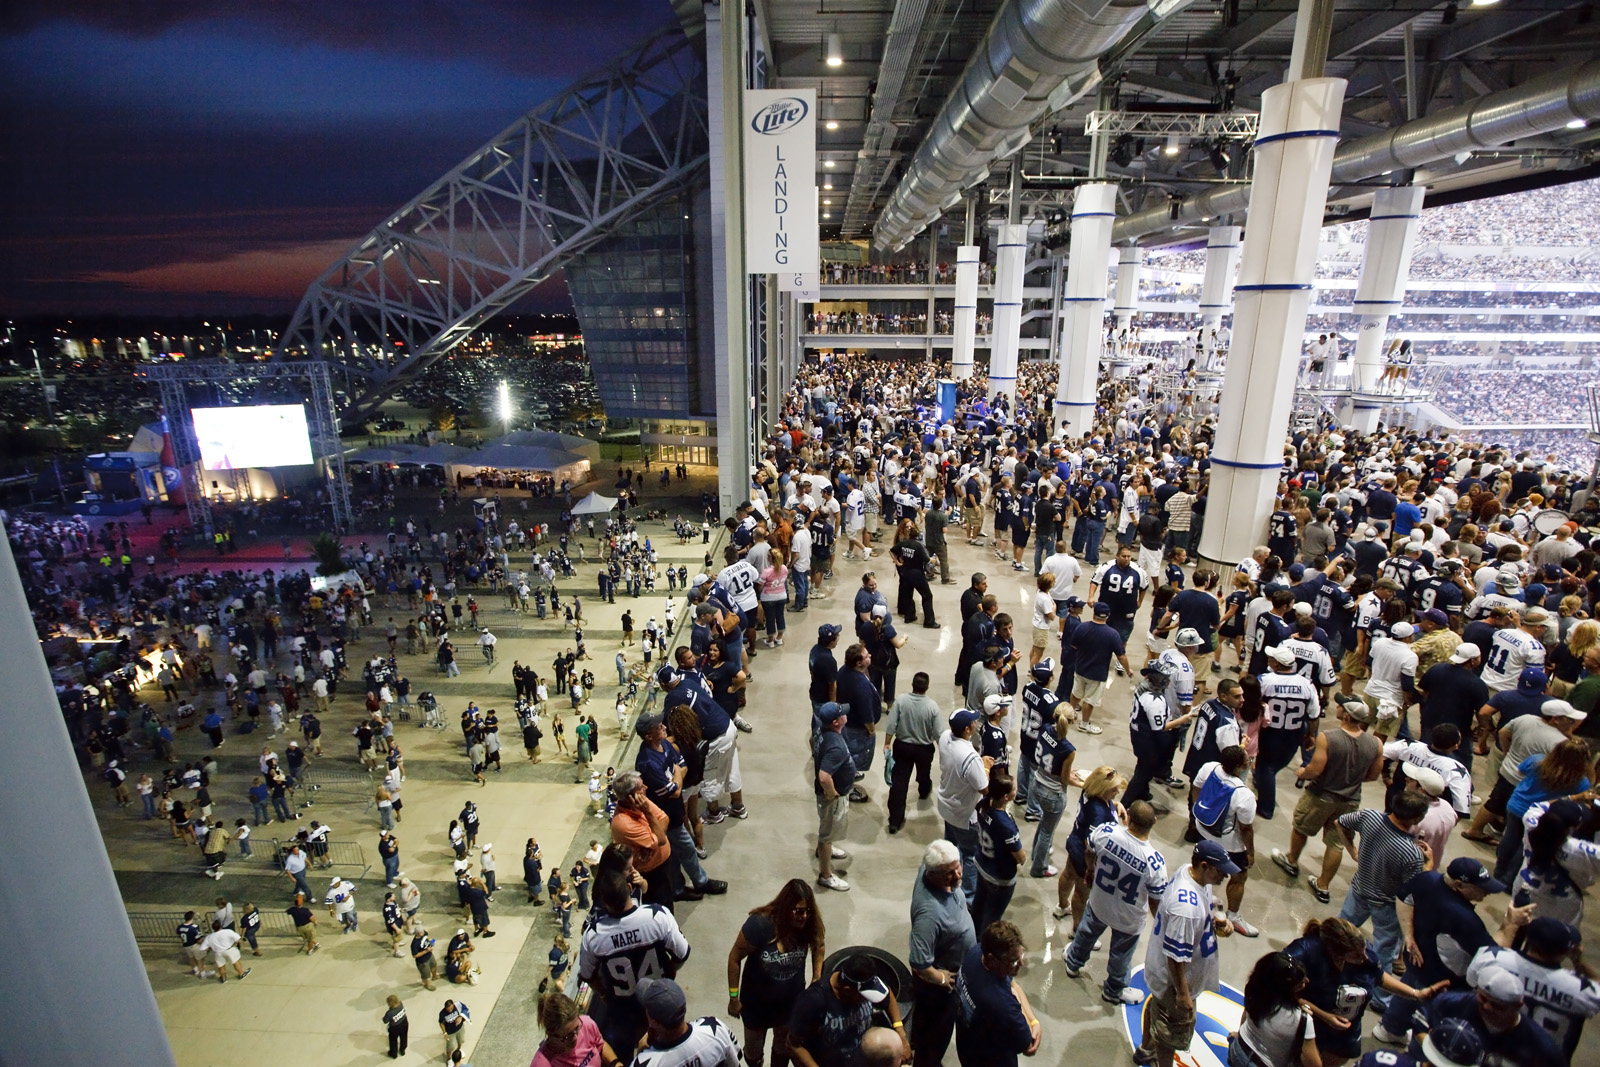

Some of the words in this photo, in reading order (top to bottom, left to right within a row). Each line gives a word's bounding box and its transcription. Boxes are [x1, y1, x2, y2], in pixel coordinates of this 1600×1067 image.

[768, 102, 793, 113] Miller
[762, 107, 800, 133] Lite
[775, 145, 788, 264] LANDING
[1420, 507, 1428, 518] 9
[731, 571, 751, 595] 12
[1108, 573, 1134, 595] 94
[1422, 588, 1437, 610] 9
[1255, 628, 1266, 652] 9
[1497, 630, 1524, 648] WILLIAMS
[1488, 644, 1510, 675] 11
[1274, 685, 1302, 695] WITTEN
[1267, 698, 1307, 731] 82
[992, 731, 1003, 740] 94
[1034, 741, 1054, 774] 24
[1104, 838, 1147, 871] BARBER
[1147, 851, 1165, 871] 24
[1095, 855, 1142, 905] 24
[1177, 888, 1198, 907] 28
[611, 929, 643, 950] WARE
[606, 948, 665, 997] 94
[1336, 984, 1368, 1021] 9
